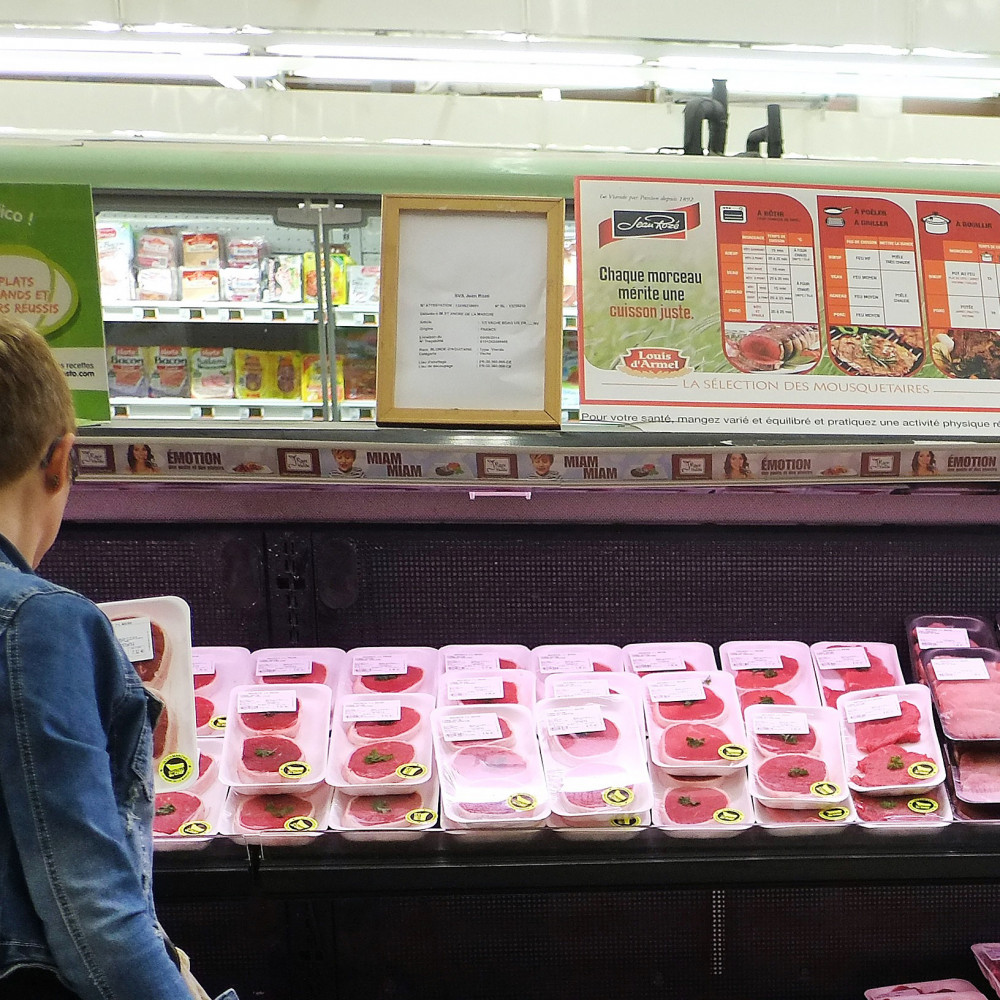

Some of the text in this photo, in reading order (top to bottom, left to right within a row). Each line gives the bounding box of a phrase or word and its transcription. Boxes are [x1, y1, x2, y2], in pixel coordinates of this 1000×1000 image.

[0, 204, 22, 223] ico
[617, 216, 653, 231] Jean
[599, 266, 702, 287] Chaque morceau
[0, 290, 49, 301] ANDS ET
[618, 286, 685, 302] mérite une
[14, 303, 59, 314] REUSSIS
[609, 303, 694, 321] cuisson juste.
[155, 355, 187, 366] Bacon
[638, 350, 671, 361] Louis
[630, 359, 679, 370] d'Armel
[683, 378, 930, 394] LA SÉLECTION DES MOUSQUETAIRES
[581, 412, 607, 422] Pour
[610, 413, 638, 422] votre
[641, 412, 675, 424] santé,
[677, 416, 720, 426] mangez
[723, 414, 749, 425] varié
[752, 416, 763, 425] et
[765, 415, 811, 428] équilibré
[814, 417, 824, 426] et
[827, 417, 877, 429] pratiquez
[902, 417, 940, 427] activité
[943, 418, 990, 430] physique
[167, 449, 222, 466] ÉMOTION
[366, 451, 402, 465] MIAM
[563, 455, 599, 468] MIAM
[761, 453, 811, 471] ÉMOTION
[947, 453, 996, 468] ÉMOTION
[387, 465, 423, 478] MIAM
[583, 467, 617, 479] MIAM
